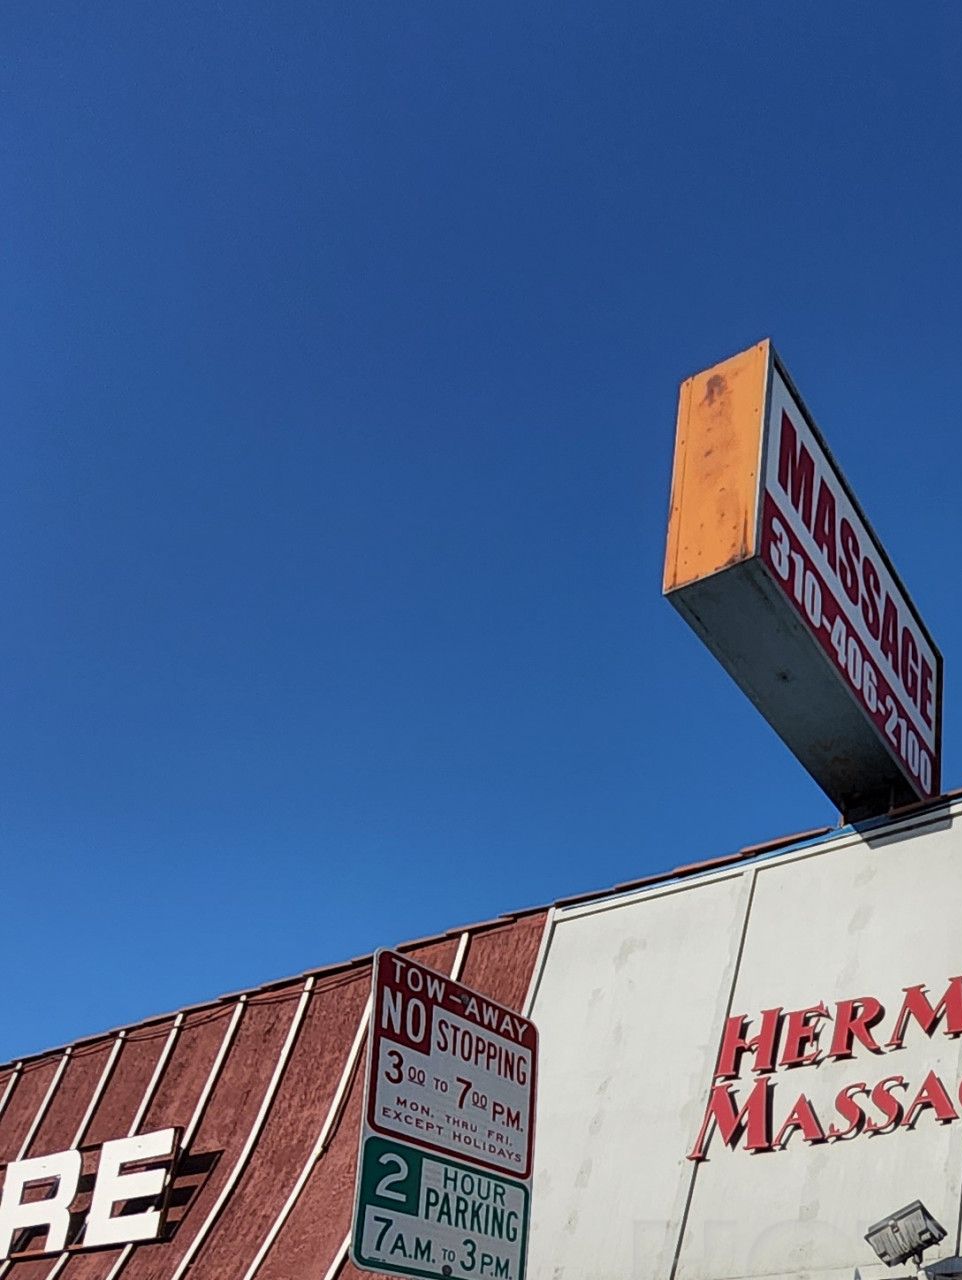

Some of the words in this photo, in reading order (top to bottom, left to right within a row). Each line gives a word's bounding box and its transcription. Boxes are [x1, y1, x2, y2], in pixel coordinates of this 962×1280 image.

[777, 407, 934, 733] MASSAGE
[768, 515, 933, 796] 310-406-2100
[381, 985, 427, 1044] NO
[436, 1018, 528, 1086] STOPPING
[396, 1096, 434, 1118] MON.
[445, 1114, 478, 1133] THRU
[487, 1129, 513, 1147] FRI.
[433, 1077, 449, 1093] TO
[491, 1101, 524, 1133] P.M.
[382, 1107, 444, 1136] EXCEPT
[452, 1131, 522, 1163] HOLIDAYS
[375, 1152, 409, 1202] 2
[443, 1166, 506, 1206] HOUR
[424, 1187, 519, 1243] PARKING
[373, 1215, 393, 1251] 7
[390, 1232, 436, 1264] A.M.
[442, 1248, 456, 1262] TO
[459, 1238, 477, 1272] 3
[480, 1253, 513, 1280] P.M.
